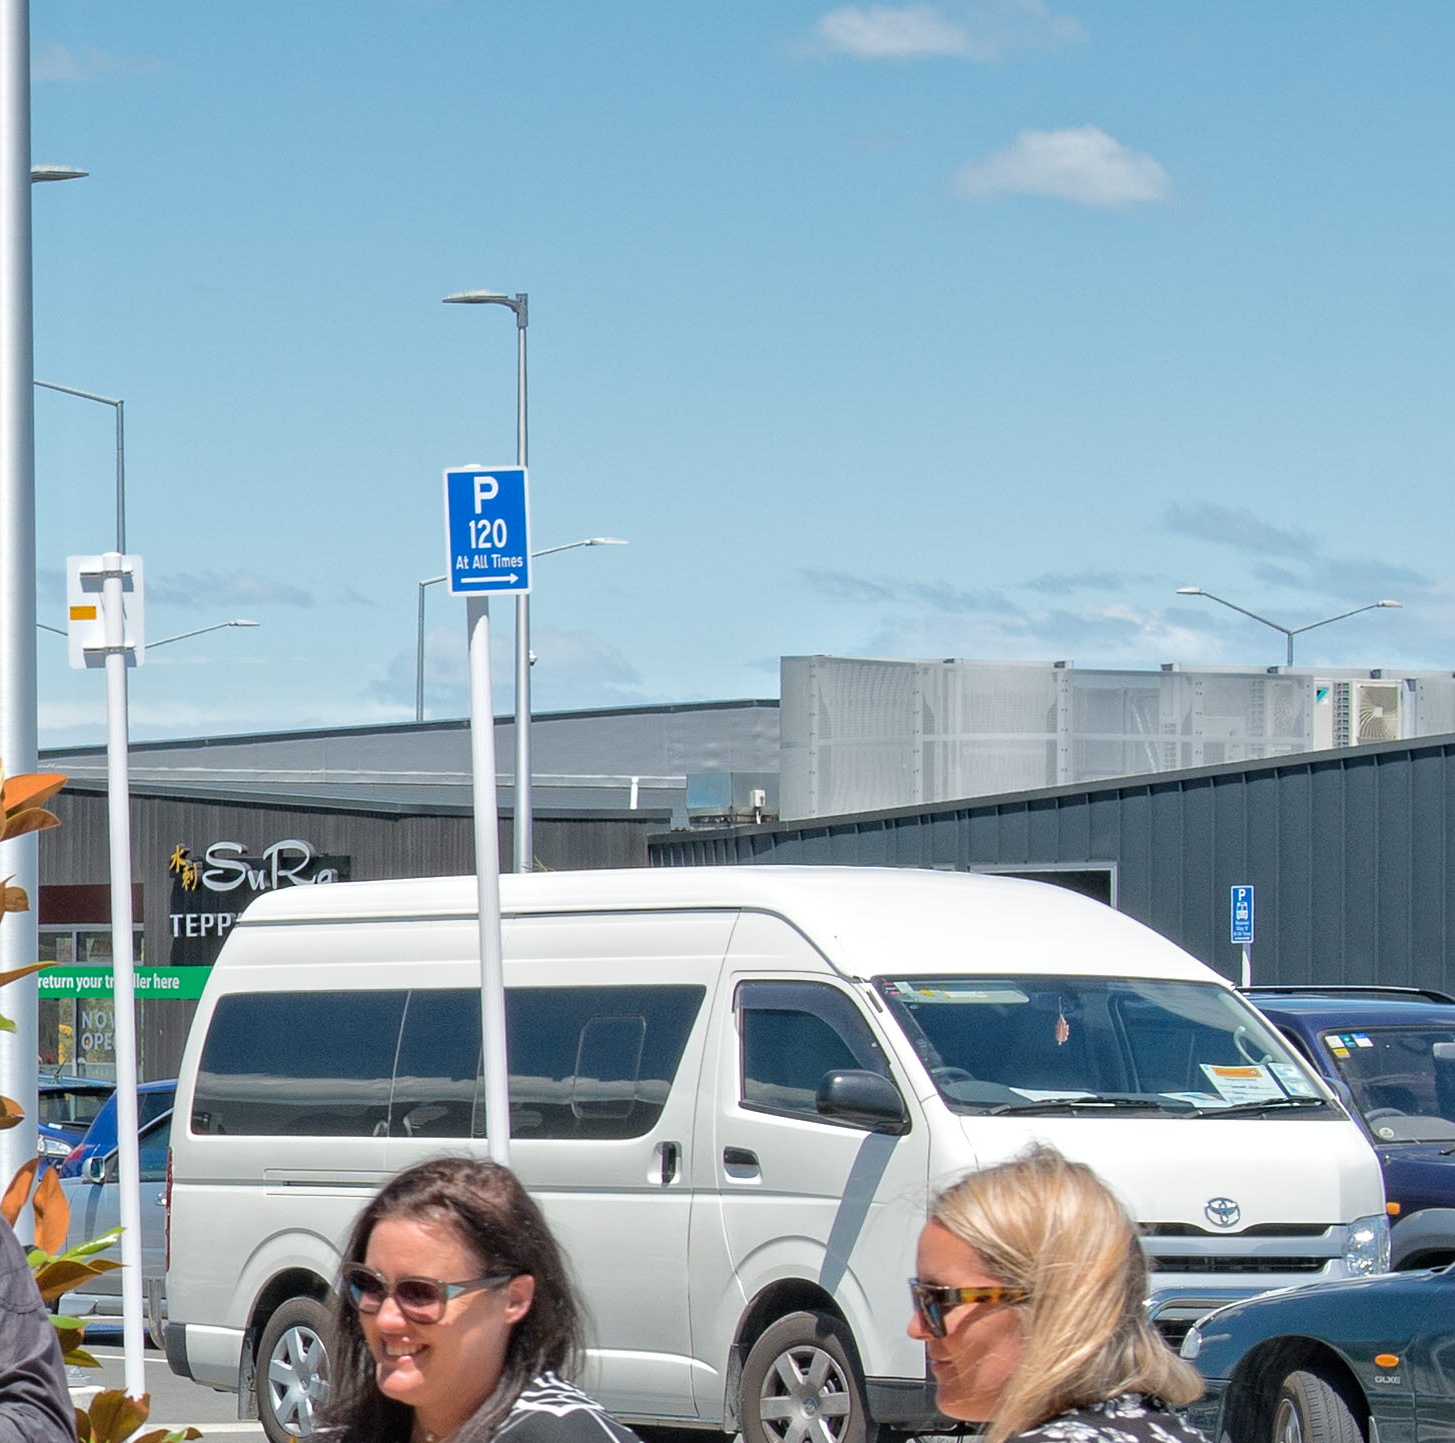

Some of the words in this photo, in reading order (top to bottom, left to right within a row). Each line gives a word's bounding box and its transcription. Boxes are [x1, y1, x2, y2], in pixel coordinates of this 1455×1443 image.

[474, 475, 499, 514] P
[469, 518, 507, 549] 120
[456, 555, 469, 570] At
[472, 554, 489, 569] All
[491, 554, 523, 569] Times
[1238, 888, 1247, 901] P
[37, 971, 74, 989] return
[76, 976, 103, 992] your
[153, 971, 180, 990] here
[82, 1033, 114, 1050] OPE
